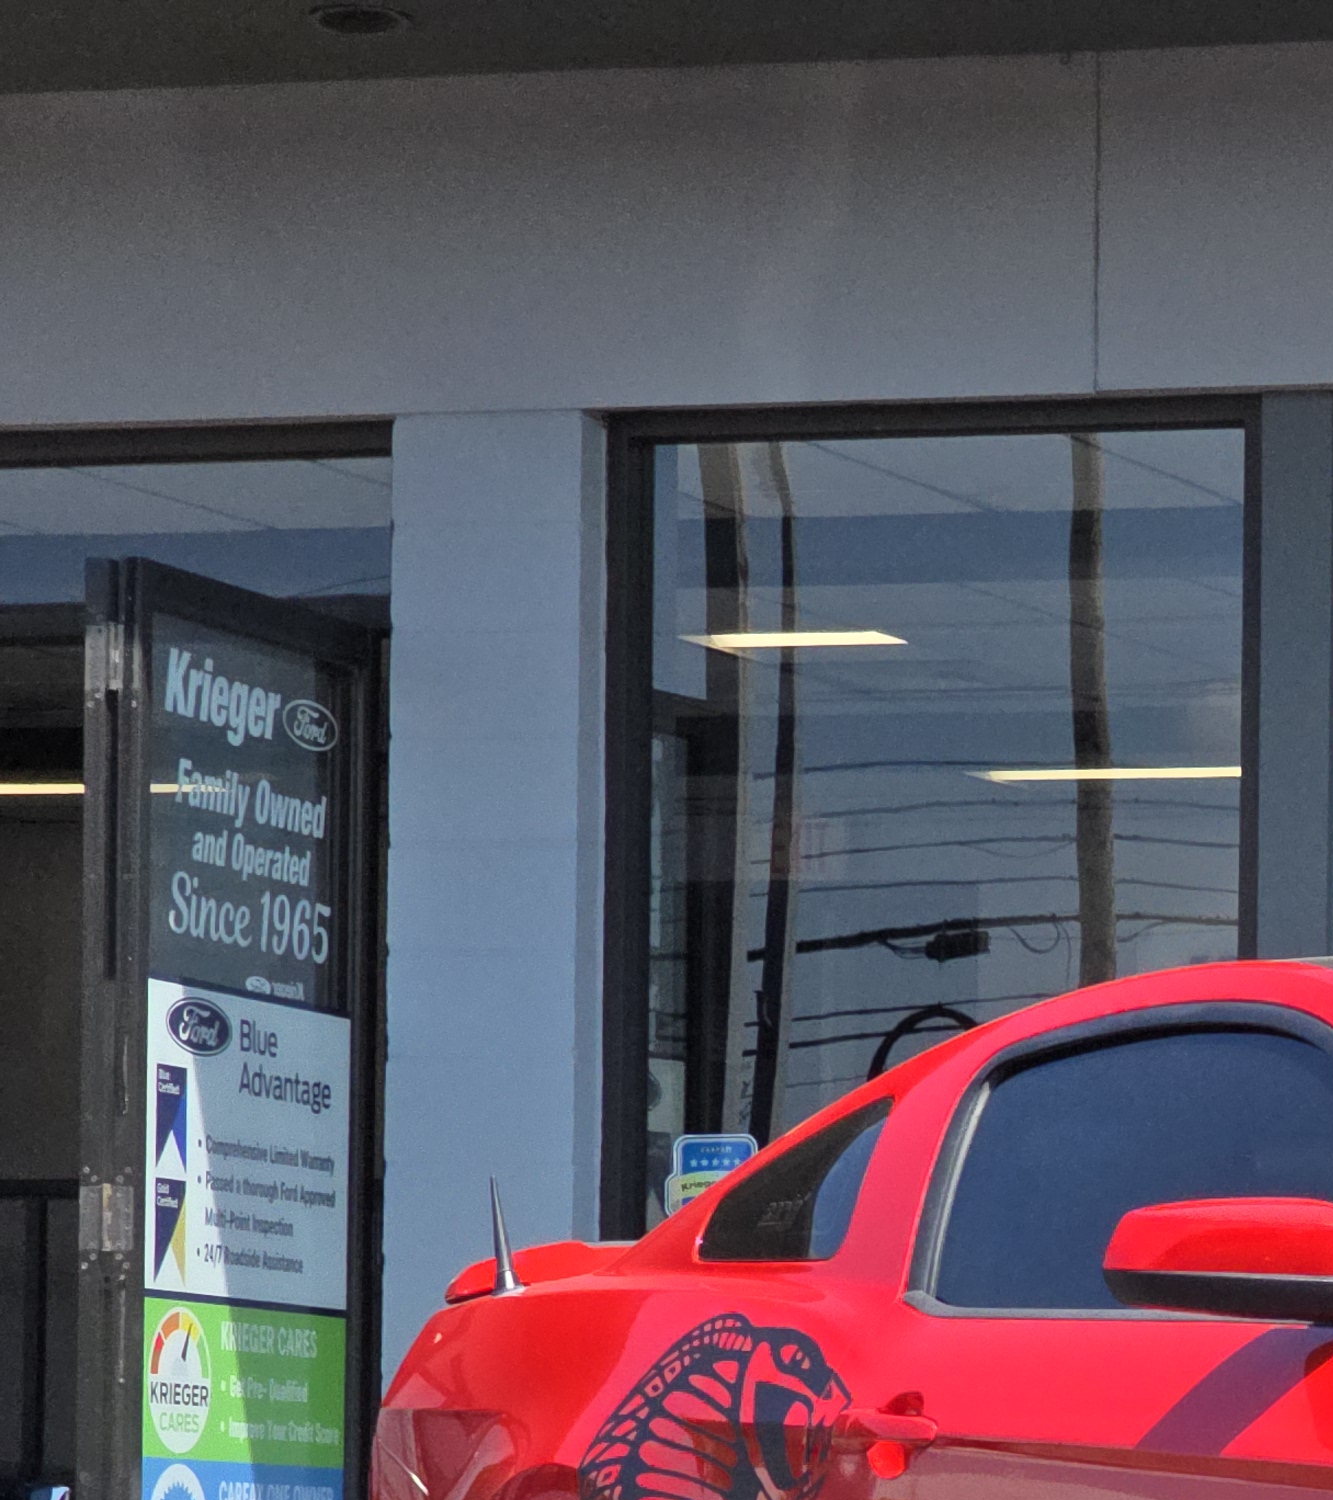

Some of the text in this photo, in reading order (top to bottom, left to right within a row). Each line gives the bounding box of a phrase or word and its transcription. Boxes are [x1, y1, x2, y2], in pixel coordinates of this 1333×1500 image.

[164, 648, 281, 747] Krieger
[175, 757, 328, 839] Family Owned
[191, 830, 311, 887] and Operated
[169, 871, 332, 964] Since 1965
[239, 1019, 278, 1058] Blue
[238, 1062, 332, 1115] Advantage
[204, 1243, 222, 1268] 24/7
[220, 1320, 318, 1359] KRIEGER CARES
[150, 1381, 209, 1407] KRIEGER
[159, 1412, 200, 1433] CARES
